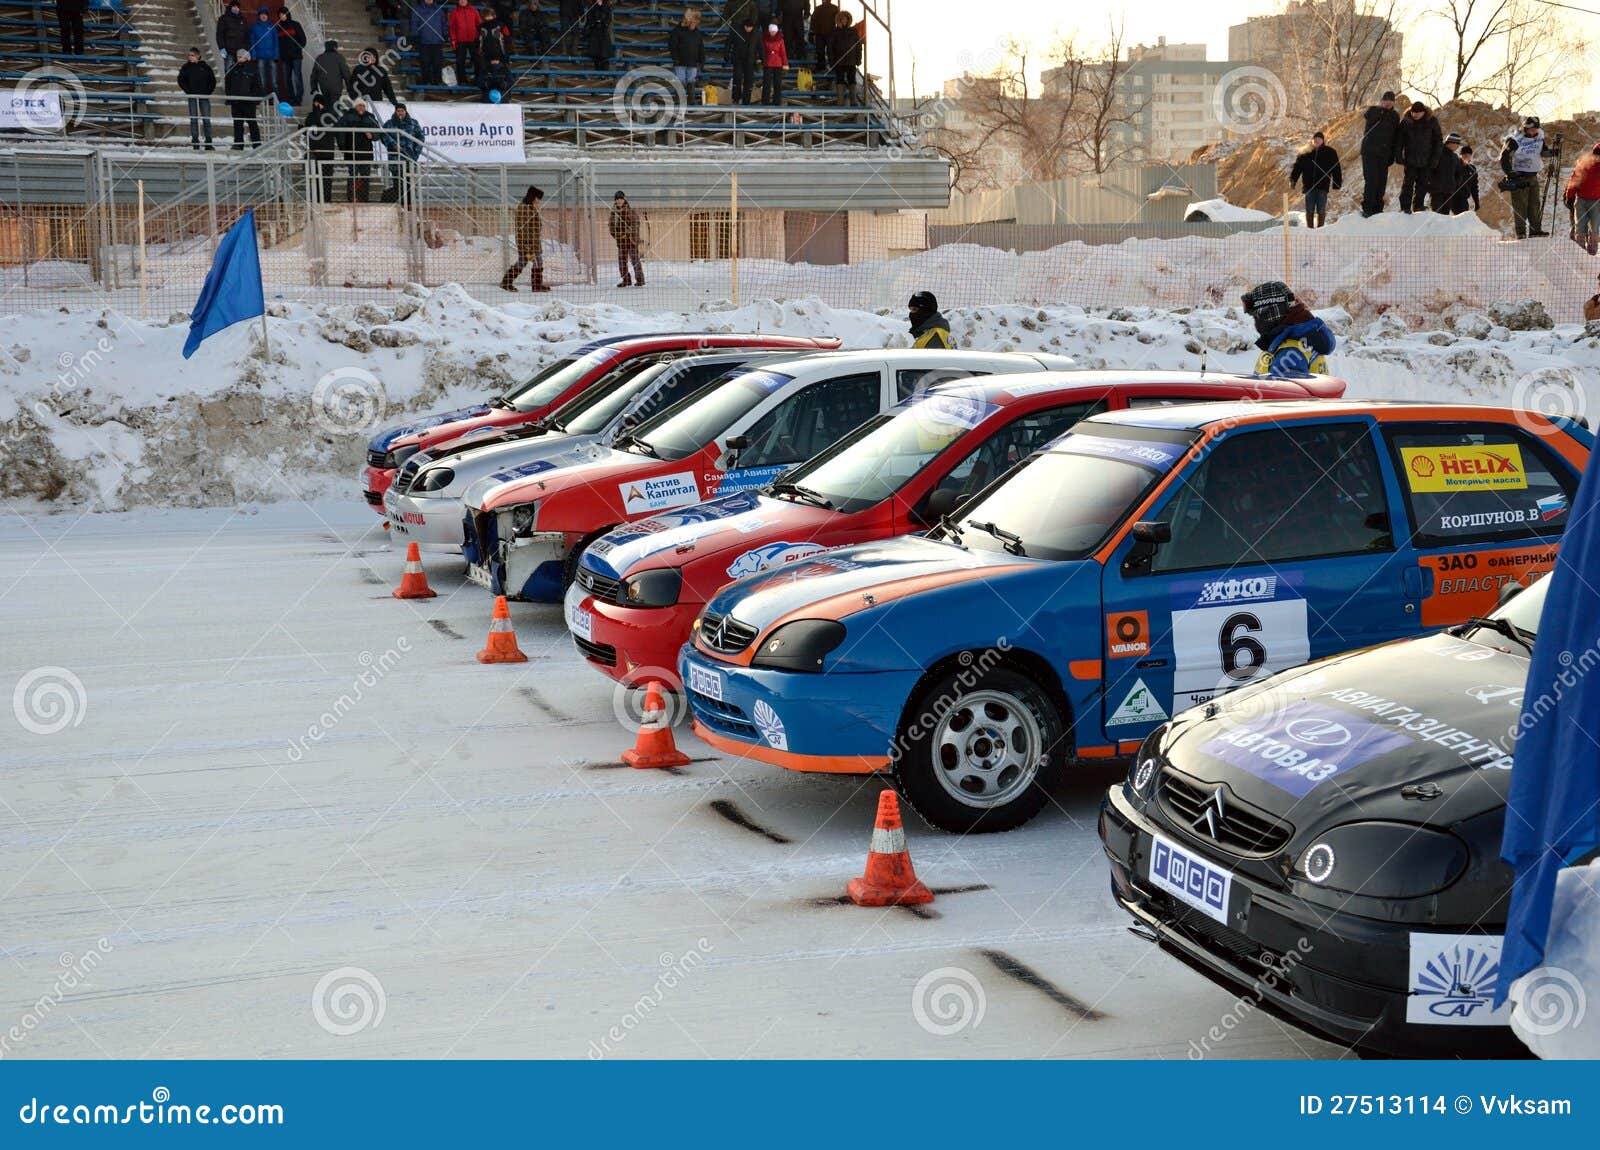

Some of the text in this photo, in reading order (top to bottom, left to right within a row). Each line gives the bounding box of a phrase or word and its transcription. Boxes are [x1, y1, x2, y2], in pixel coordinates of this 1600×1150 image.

[479, 122, 514, 139] Арго
[1254, 296, 1287, 307] SWANS
[1440, 457, 1516, 475] HELIX
[645, 479, 681, 491] Актив
[1493, 477, 1521, 485] масла
[646, 485, 696, 500] Капитал
[1437, 554, 1478, 571] ЗАО
[1218, 611, 1268, 681] 6
[1216, 729, 1338, 781] АВТОВАЗ
[1155, 845, 1225, 907] ГФСО
